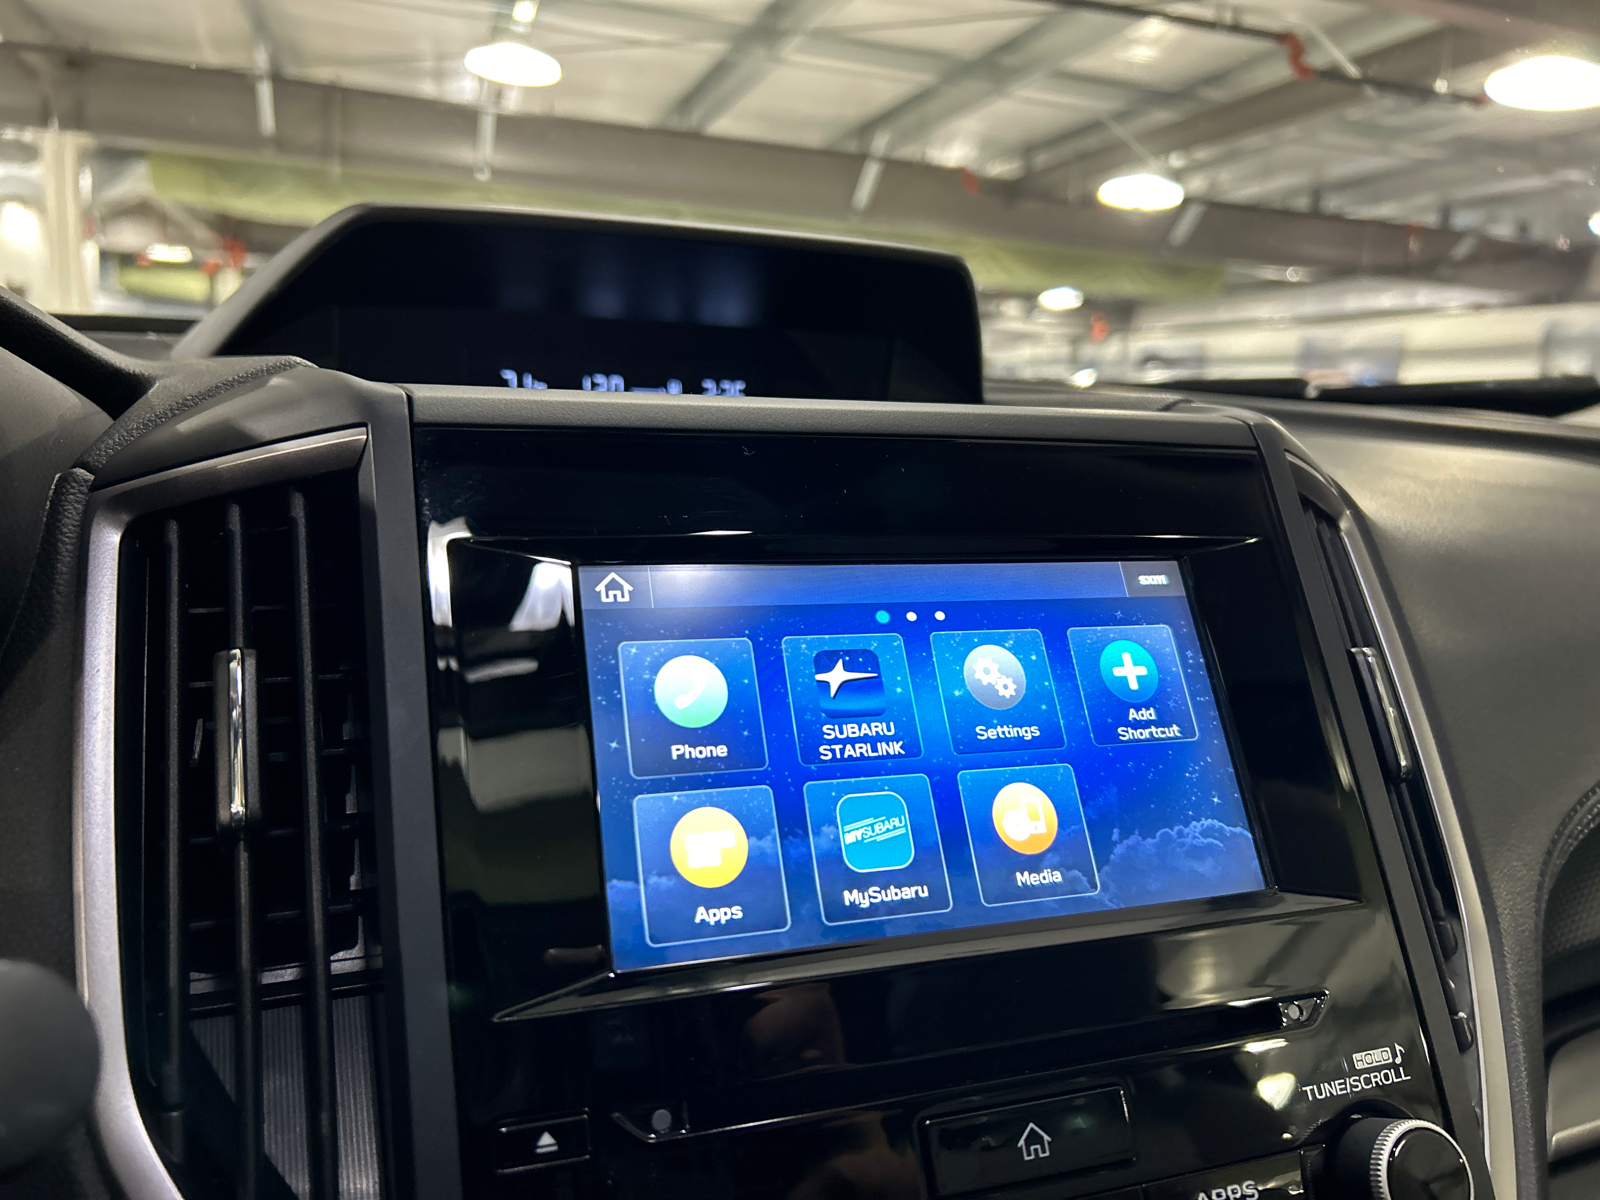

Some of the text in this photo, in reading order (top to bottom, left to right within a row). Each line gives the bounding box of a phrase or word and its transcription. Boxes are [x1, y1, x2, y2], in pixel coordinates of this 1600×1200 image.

[1128, 707, 1155, 721] Add
[822, 721, 896, 739] SUBARU
[975, 725, 1040, 740] Settings
[1117, 723, 1182, 740] Shortcut
[671, 744, 728, 760] Phone
[818, 741, 905, 760] STARLINK
[1015, 868, 1062, 887] Media
[843, 884, 929, 907] MySubaru
[694, 905, 743, 925] Apps
[1354, 1049, 1390, 1067] HOLD
[1302, 1066, 1411, 1101] TUNE/SCROLL
